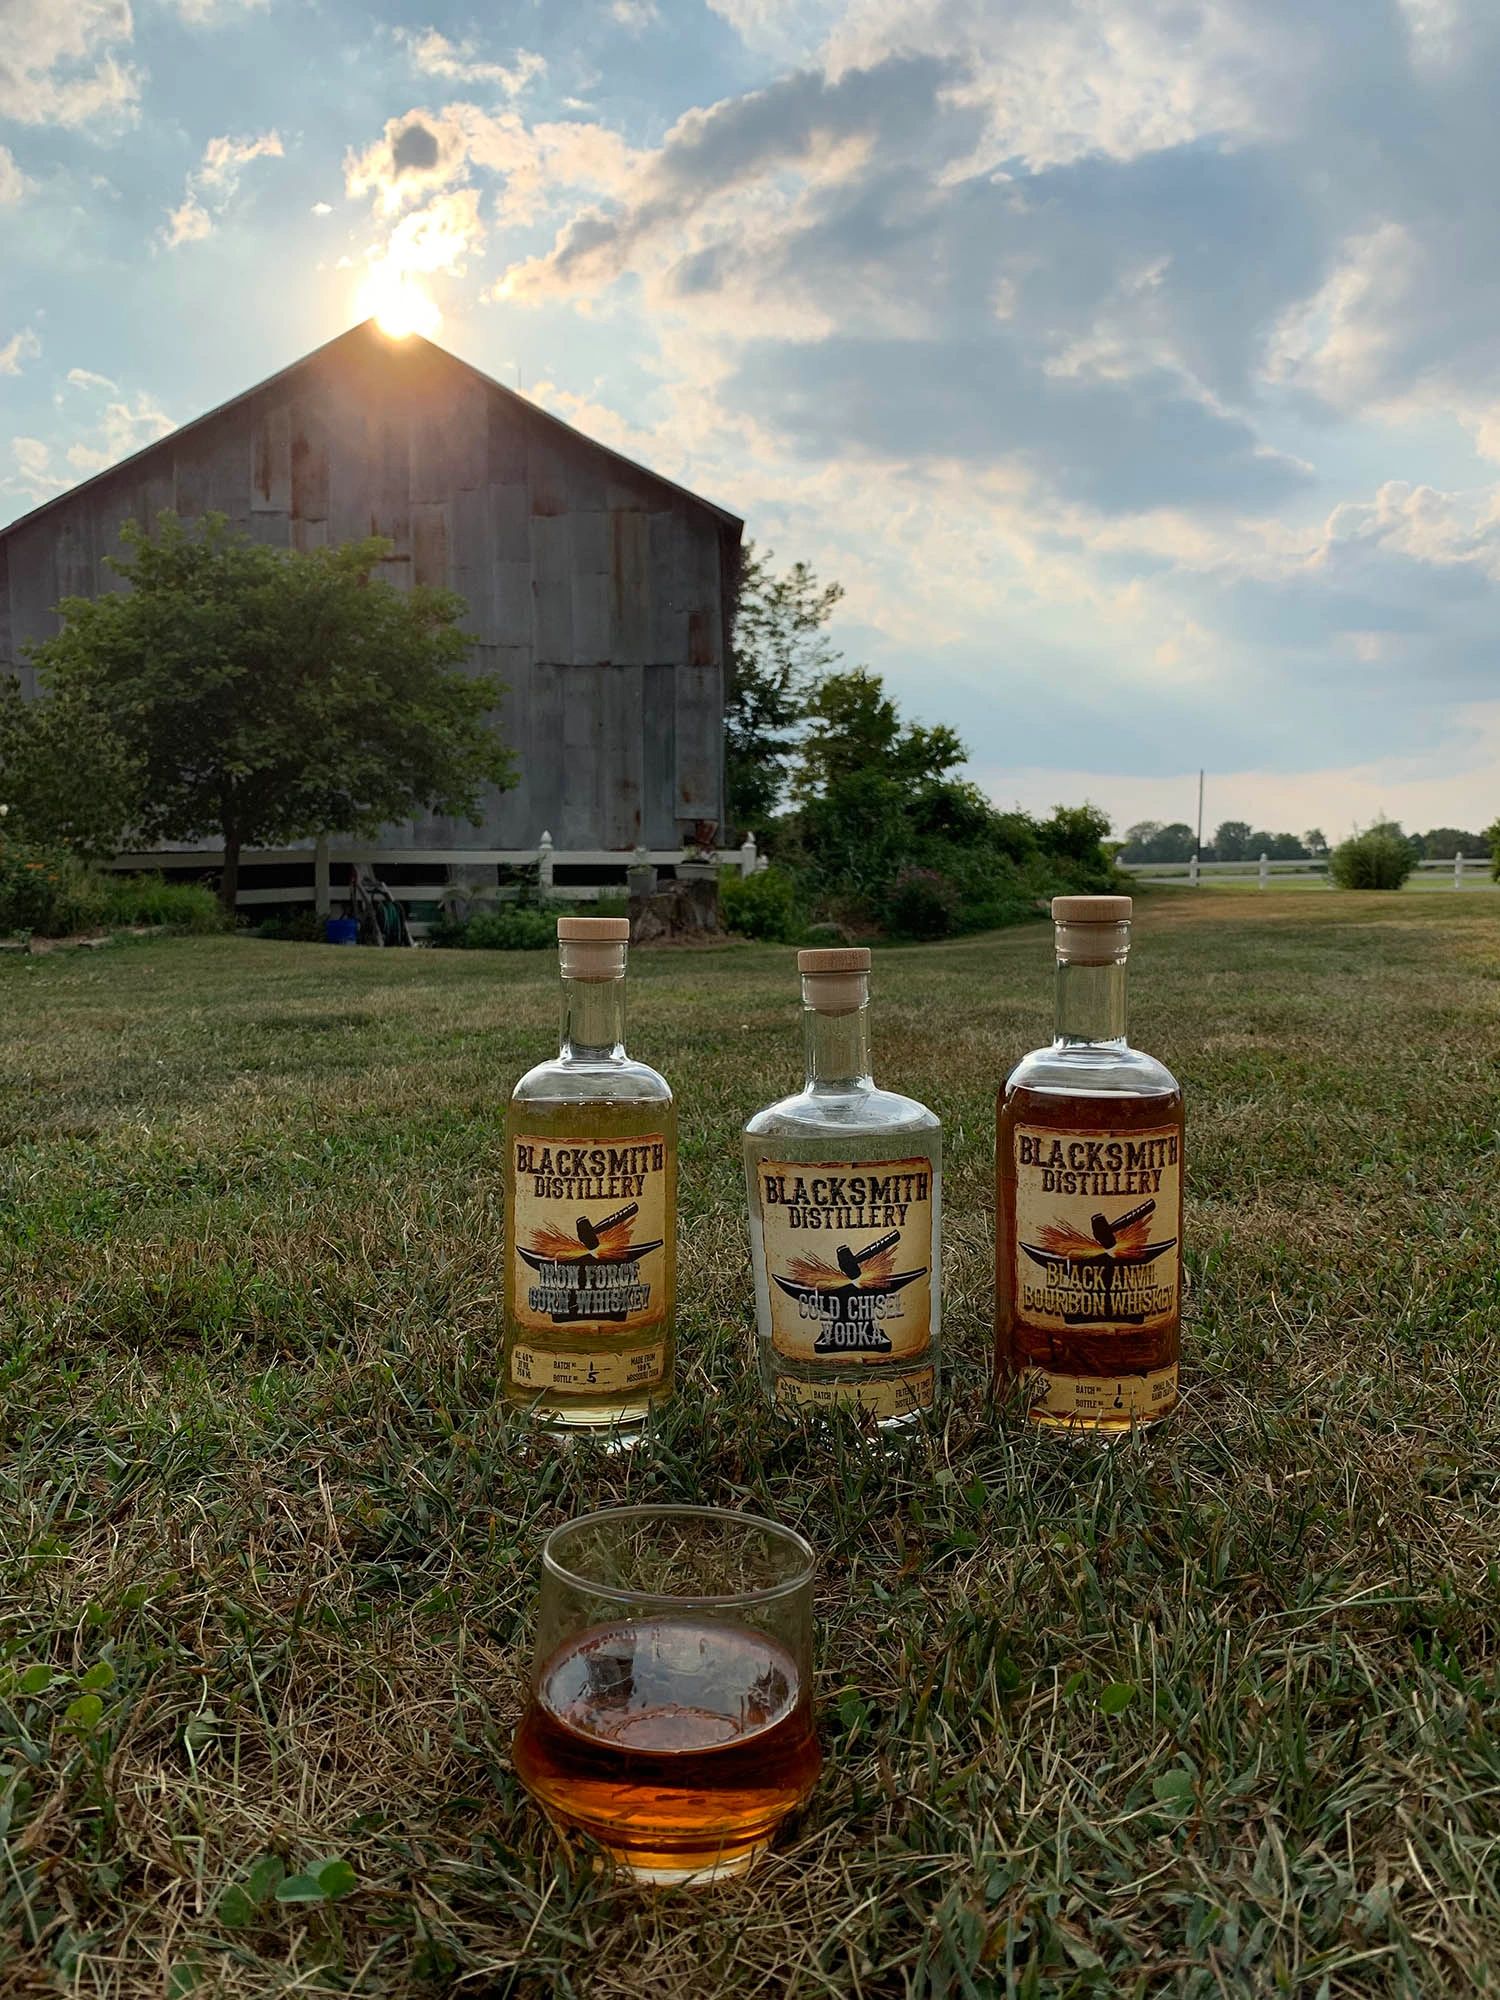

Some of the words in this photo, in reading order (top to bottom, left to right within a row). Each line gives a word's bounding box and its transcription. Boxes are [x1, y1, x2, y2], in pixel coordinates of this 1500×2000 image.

[516, 1144, 664, 1177] BLACKSMITH
[1018, 1135, 1178, 1172] BLACKSMITH
[534, 1174, 646, 1200] DISTILLERY
[763, 1172, 928, 1206] BLACKSMITH
[1041, 1168, 1163, 1196] DISTILLERY
[788, 1204, 909, 1230] DISTILLERY
[539, 1262, 580, 1290] IRON
[585, 1261, 640, 1289] FORGE
[1046, 1261, 1105, 1291] BLACK
[1110, 1263, 1158, 1292] ANVIL
[529, 1286, 571, 1314] CORN
[575, 1285, 650, 1315] WHISKEY
[799, 1293, 841, 1321] COLD
[847, 1292, 905, 1321] CHISEL
[1023, 1284, 1106, 1317] BOURBON
[1109, 1285, 1174, 1316] WHISKEY
[820, 1320, 884, 1347] VODKA
[586, 1371, 600, 1384] 5
